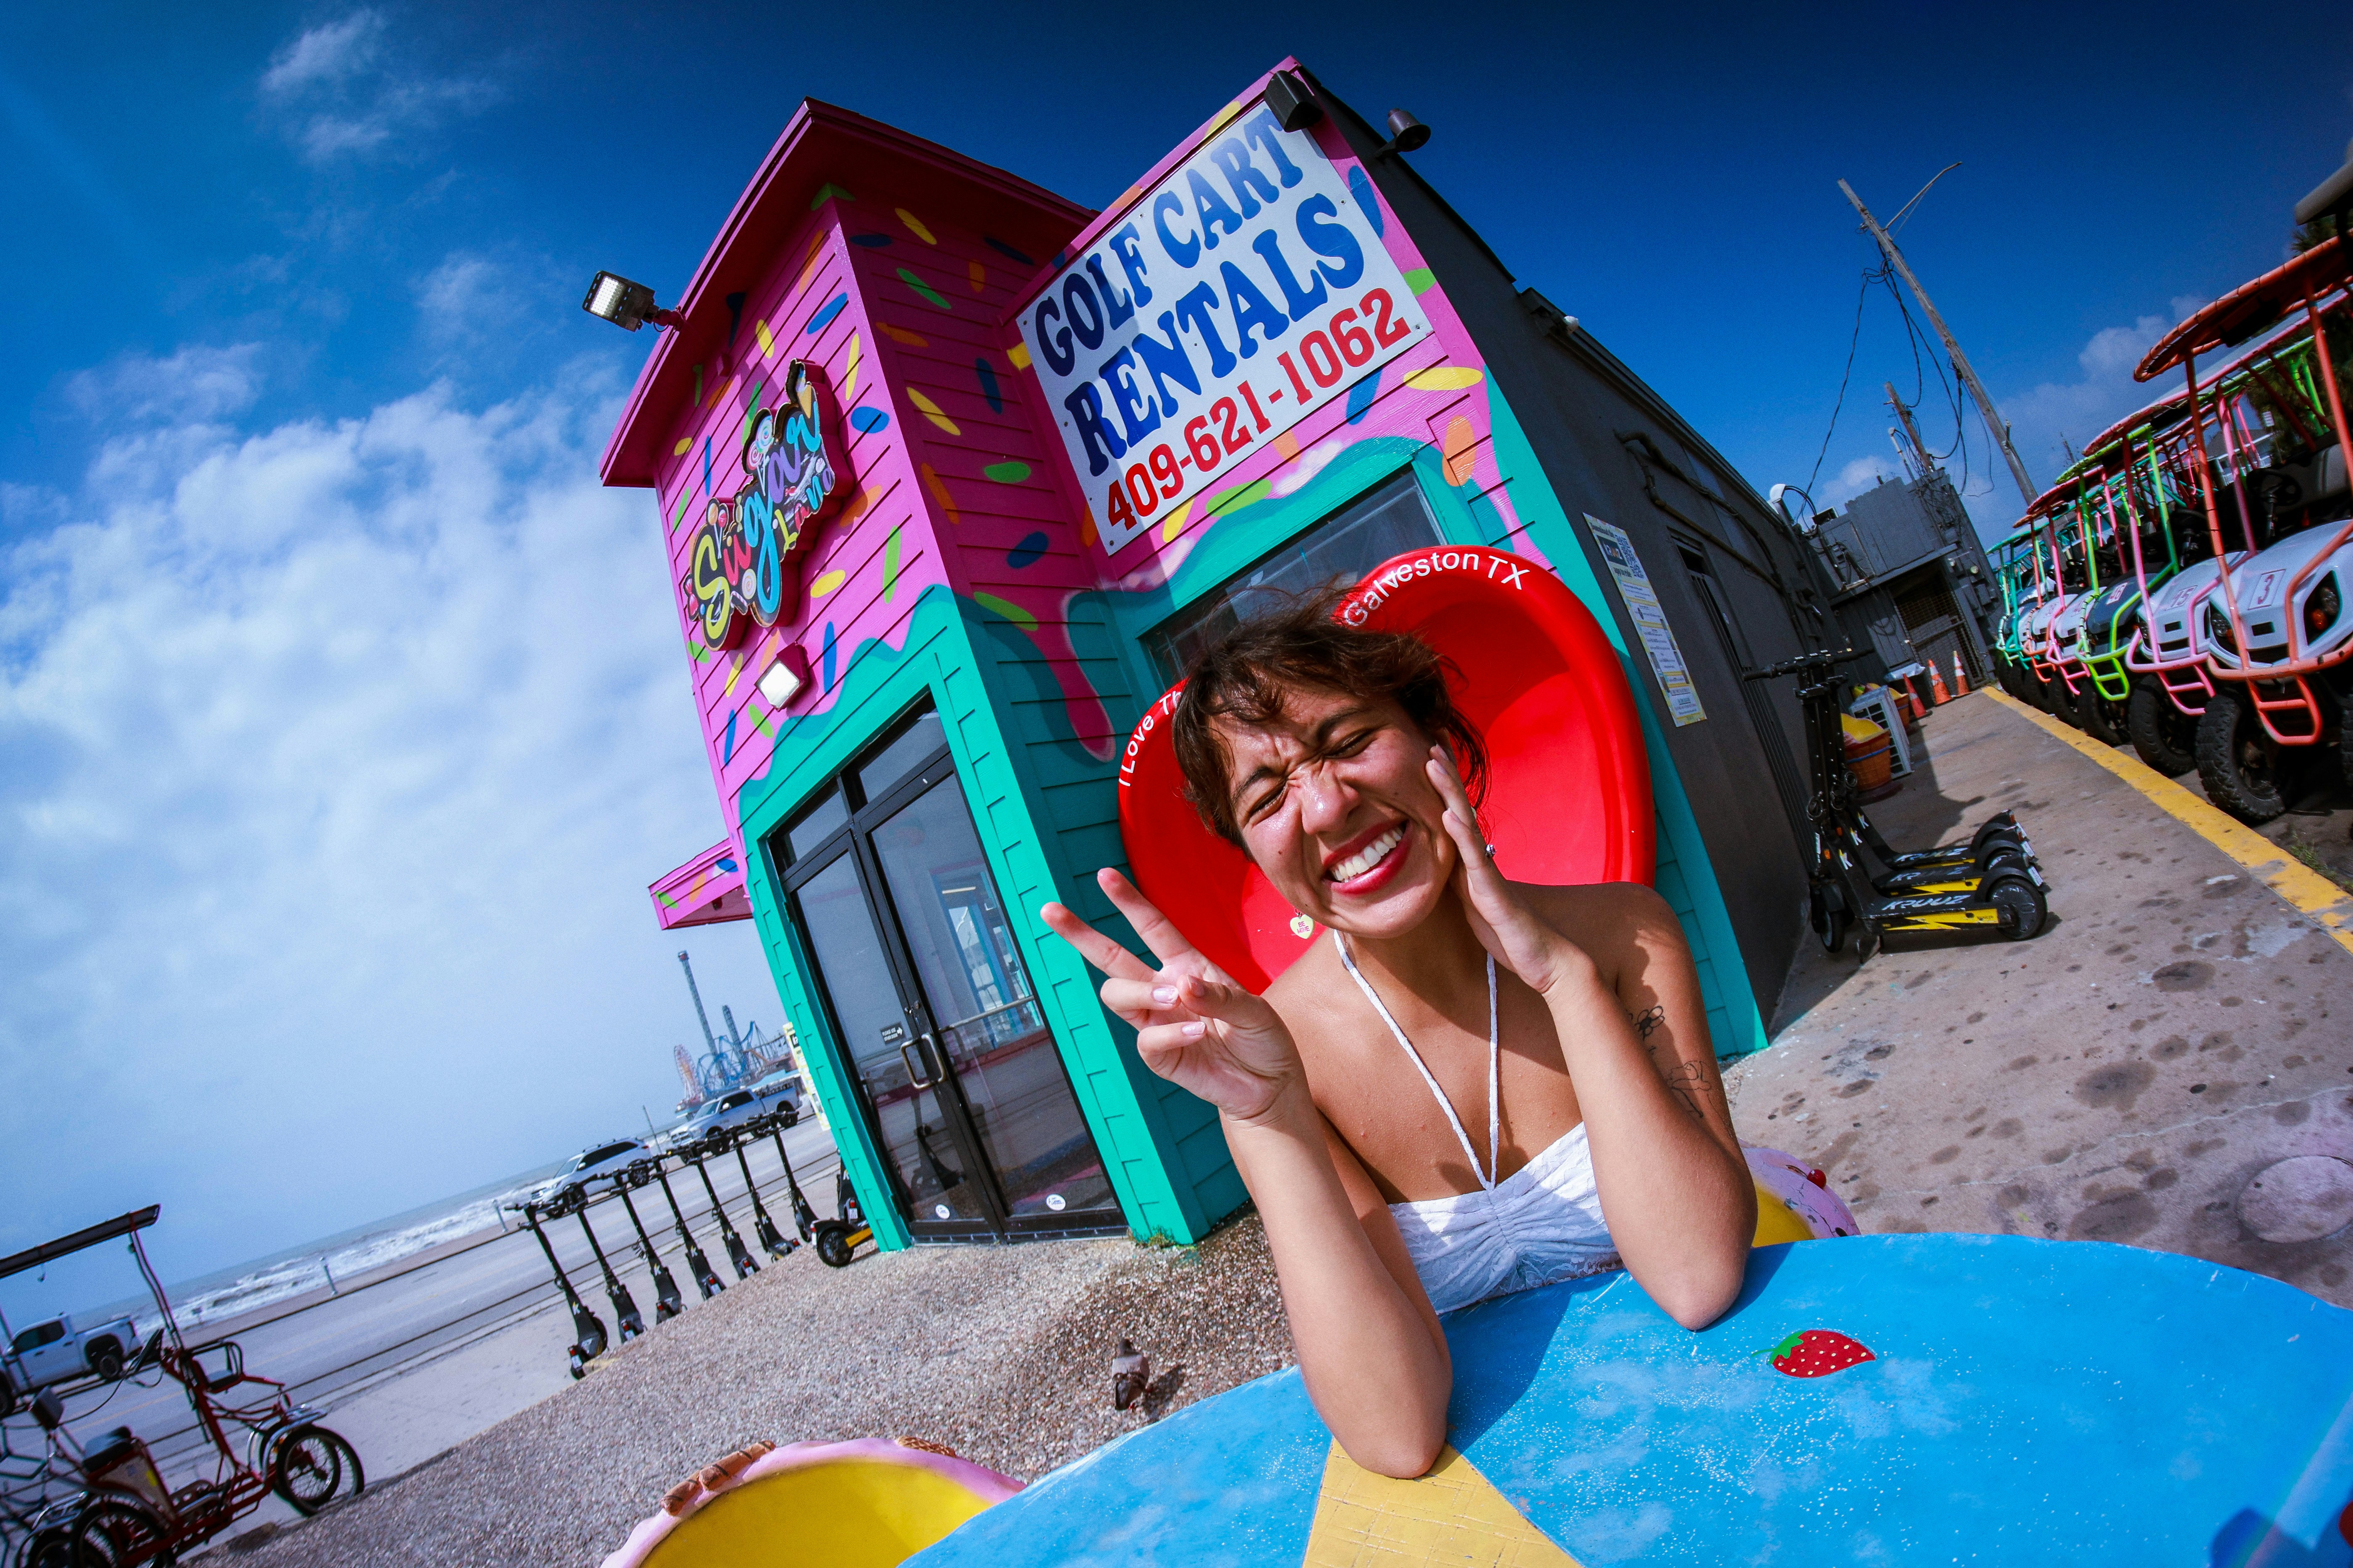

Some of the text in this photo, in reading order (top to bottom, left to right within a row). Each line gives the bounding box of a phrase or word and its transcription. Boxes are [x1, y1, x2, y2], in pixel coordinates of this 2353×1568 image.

[1035, 108, 1303, 376] GOLF CART
[1065, 193, 1364, 477] RENTALS
[1107, 287, 1411, 531] 409-621-1062
[694, 401, 820, 639] Sugar
[1344, 552, 1530, 627] Galveston TX
[2257, 574, 2274, 605] 3
[1121, 715, 1154, 774] Love
[1118, 777, 1131, 787] I
[1297, 925, 1310, 934] MINE
[1881, 894, 1971, 911] KRUUZ
